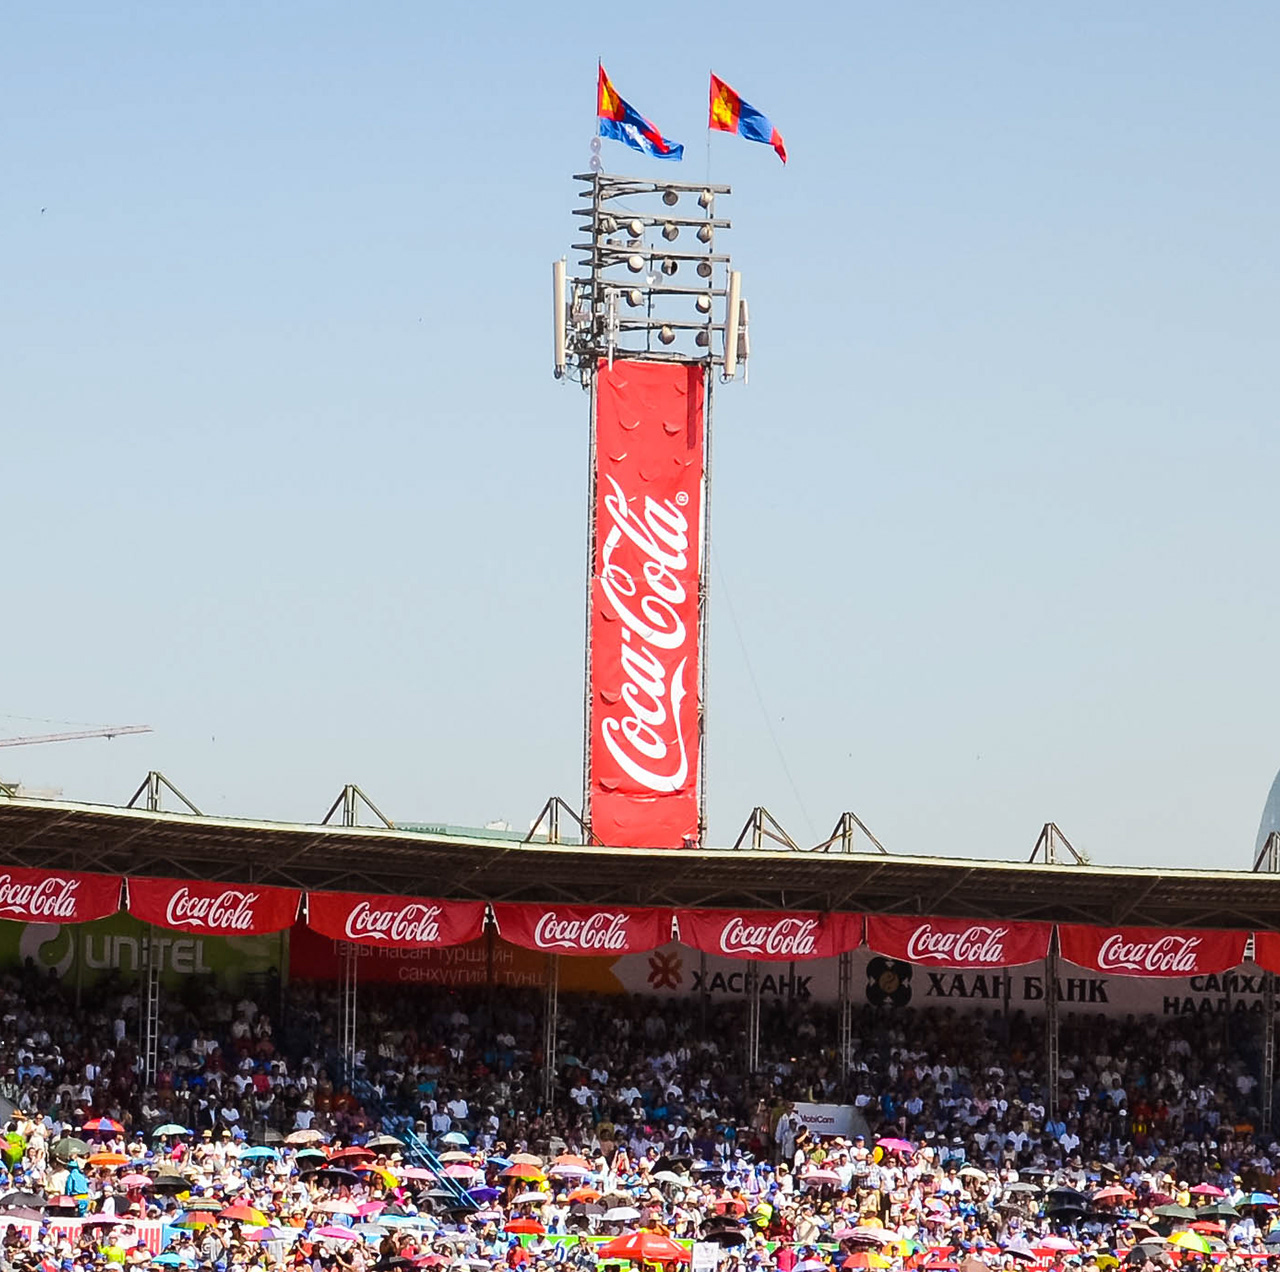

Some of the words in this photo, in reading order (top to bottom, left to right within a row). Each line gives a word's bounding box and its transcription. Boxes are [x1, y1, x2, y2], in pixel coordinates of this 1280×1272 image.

[601, 474, 688, 792] Coca-Cola
[167, 887, 258, 929] Coca-Cola
[346, 902, 442, 941] Coca-Cola
[535, 912, 629, 948] Coca-Cola
[720, 918, 818, 954] Coca-Cola
[908, 924, 1009, 961] Coca-Cola
[1098, 934, 1202, 970] Coca-Cola
[926, 972, 1012, 1000] ХААН
